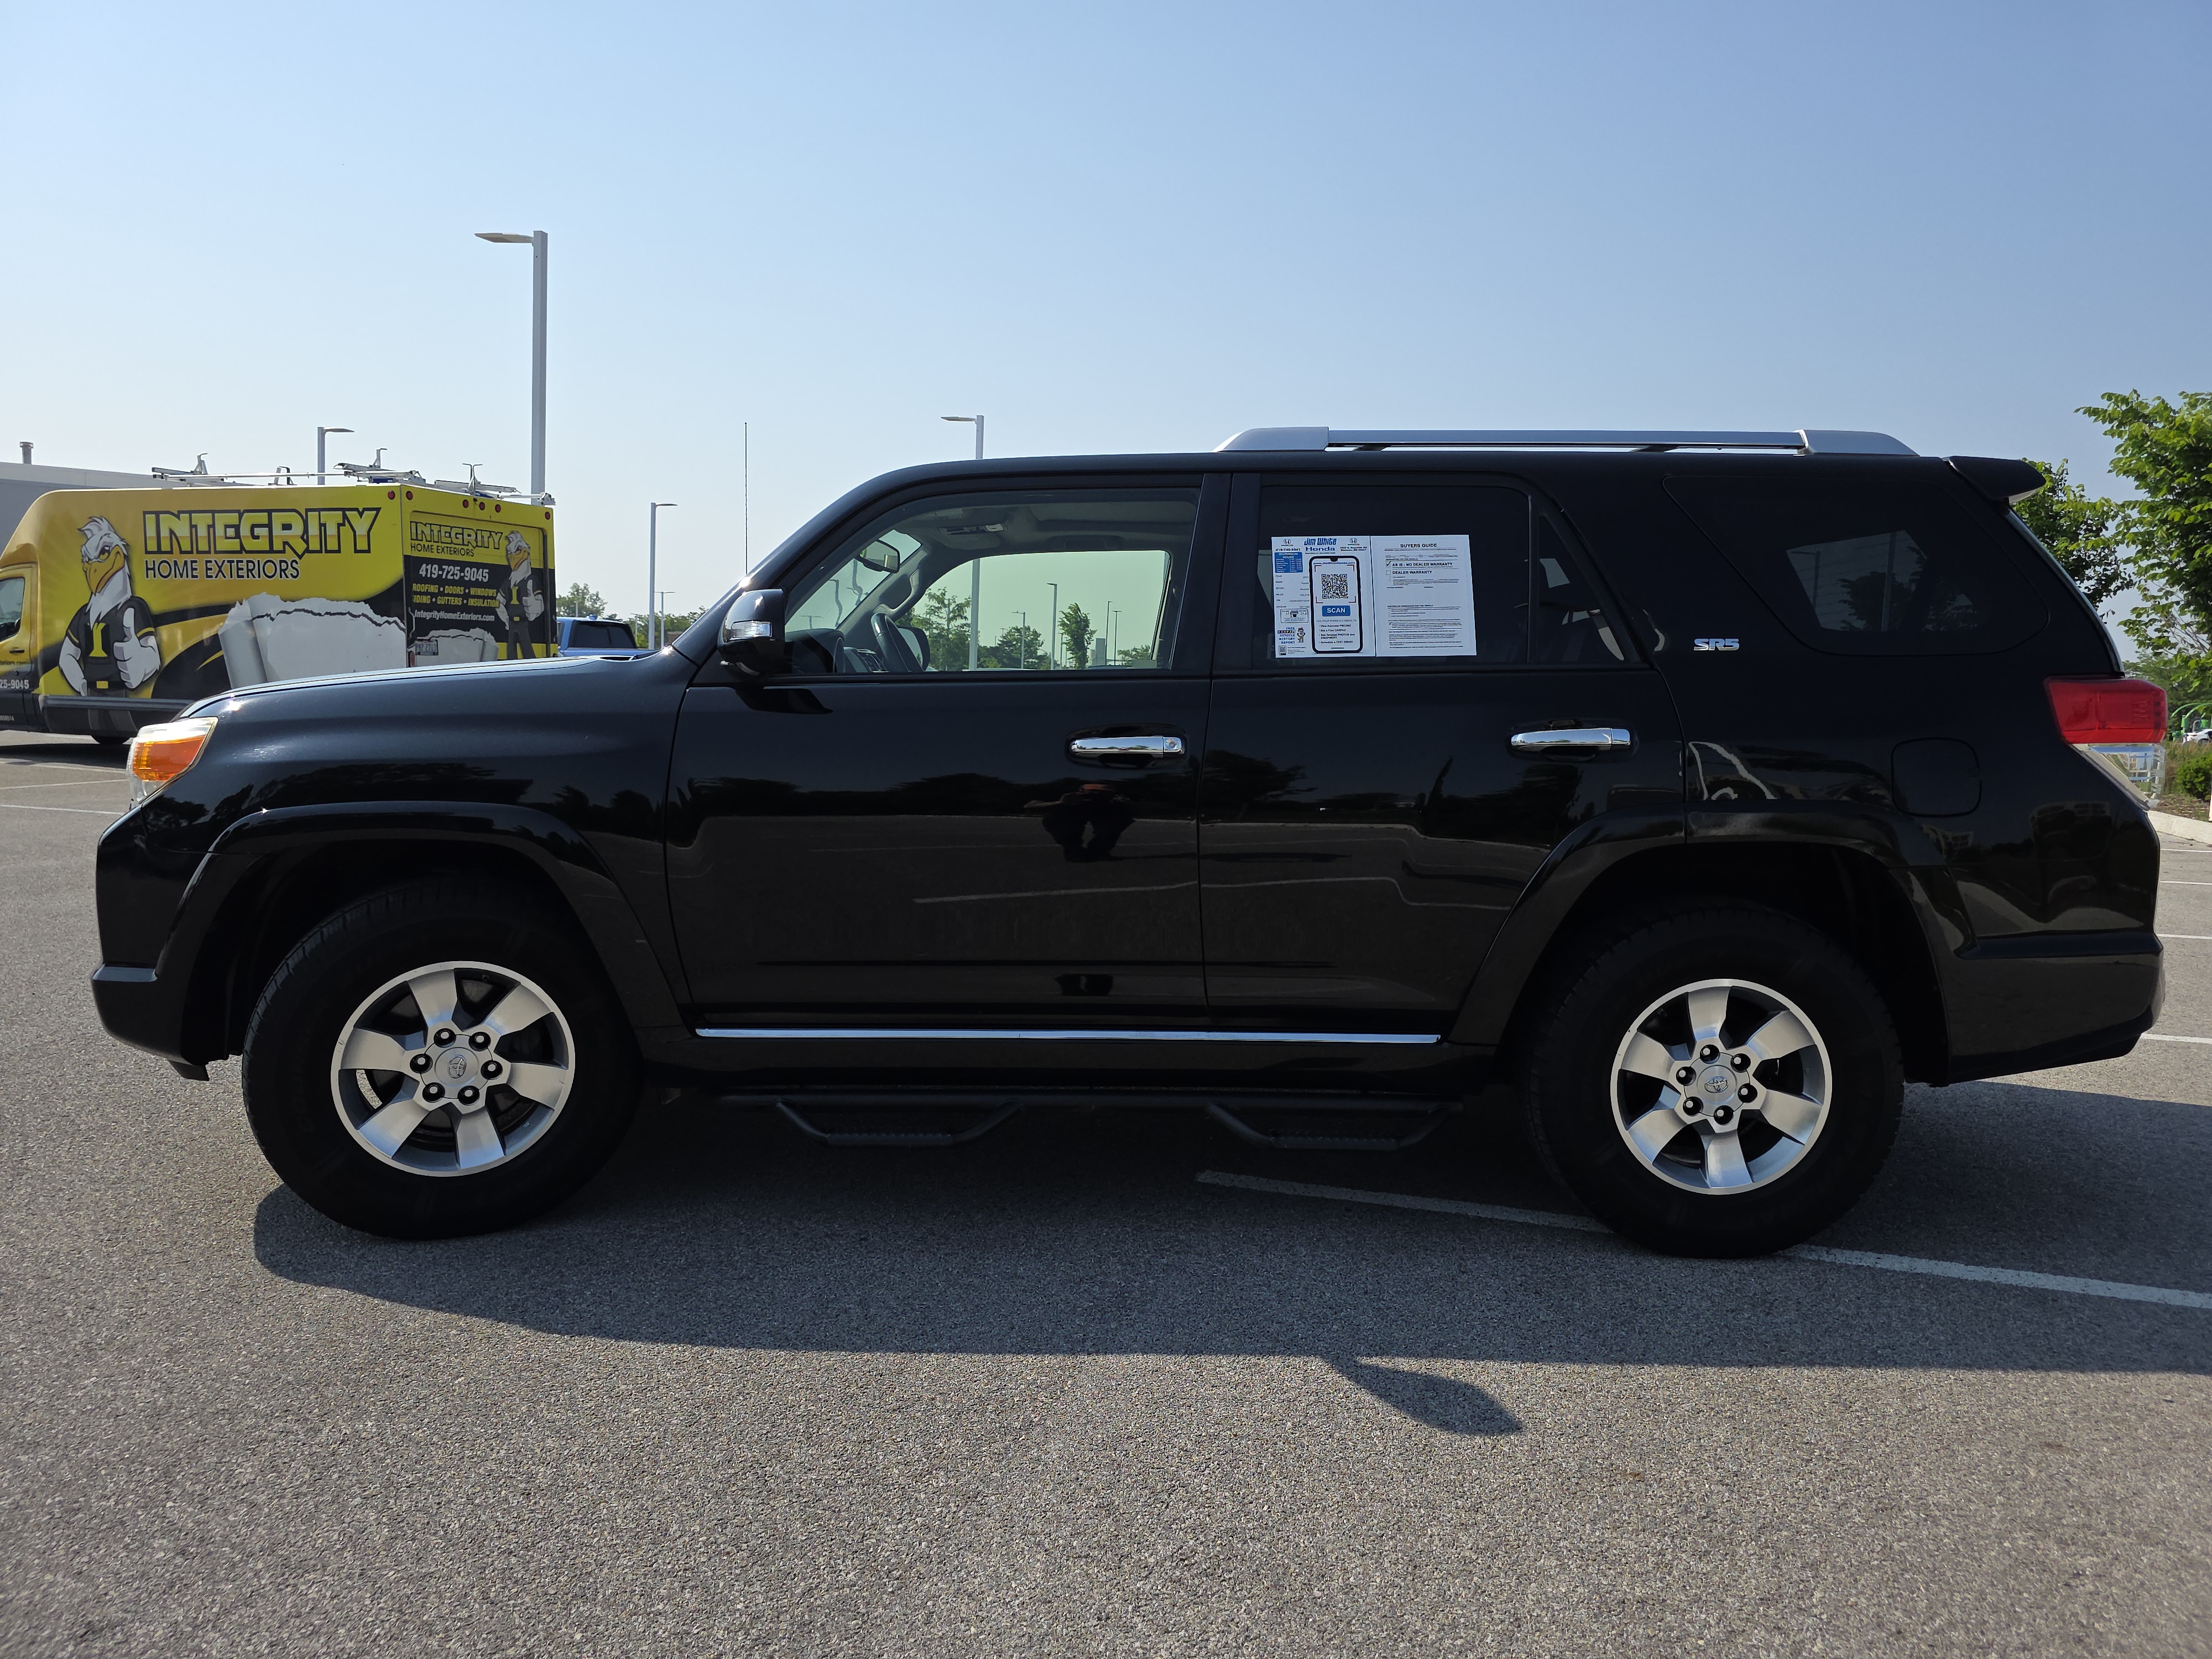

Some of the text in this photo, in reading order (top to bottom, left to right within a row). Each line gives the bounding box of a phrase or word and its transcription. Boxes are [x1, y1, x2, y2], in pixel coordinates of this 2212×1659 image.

[143, 507, 382, 560] INTEGRITY
[410, 520, 504, 550] INTEGRITY
[410, 542, 474, 557] HOME EXTERIORS
[144, 559, 301, 580] HOME EXTERIORS
[419, 563, 489, 582] 419-725-9045
[412, 583, 497, 597] ROOFING DOORS WINDOWS
[413, 594, 500, 609] IDING GUTTERS INSULATION
[414, 609, 495, 622] IntegrityHomeExteriors.com
[1693, 638, 1740, 651] SR5
